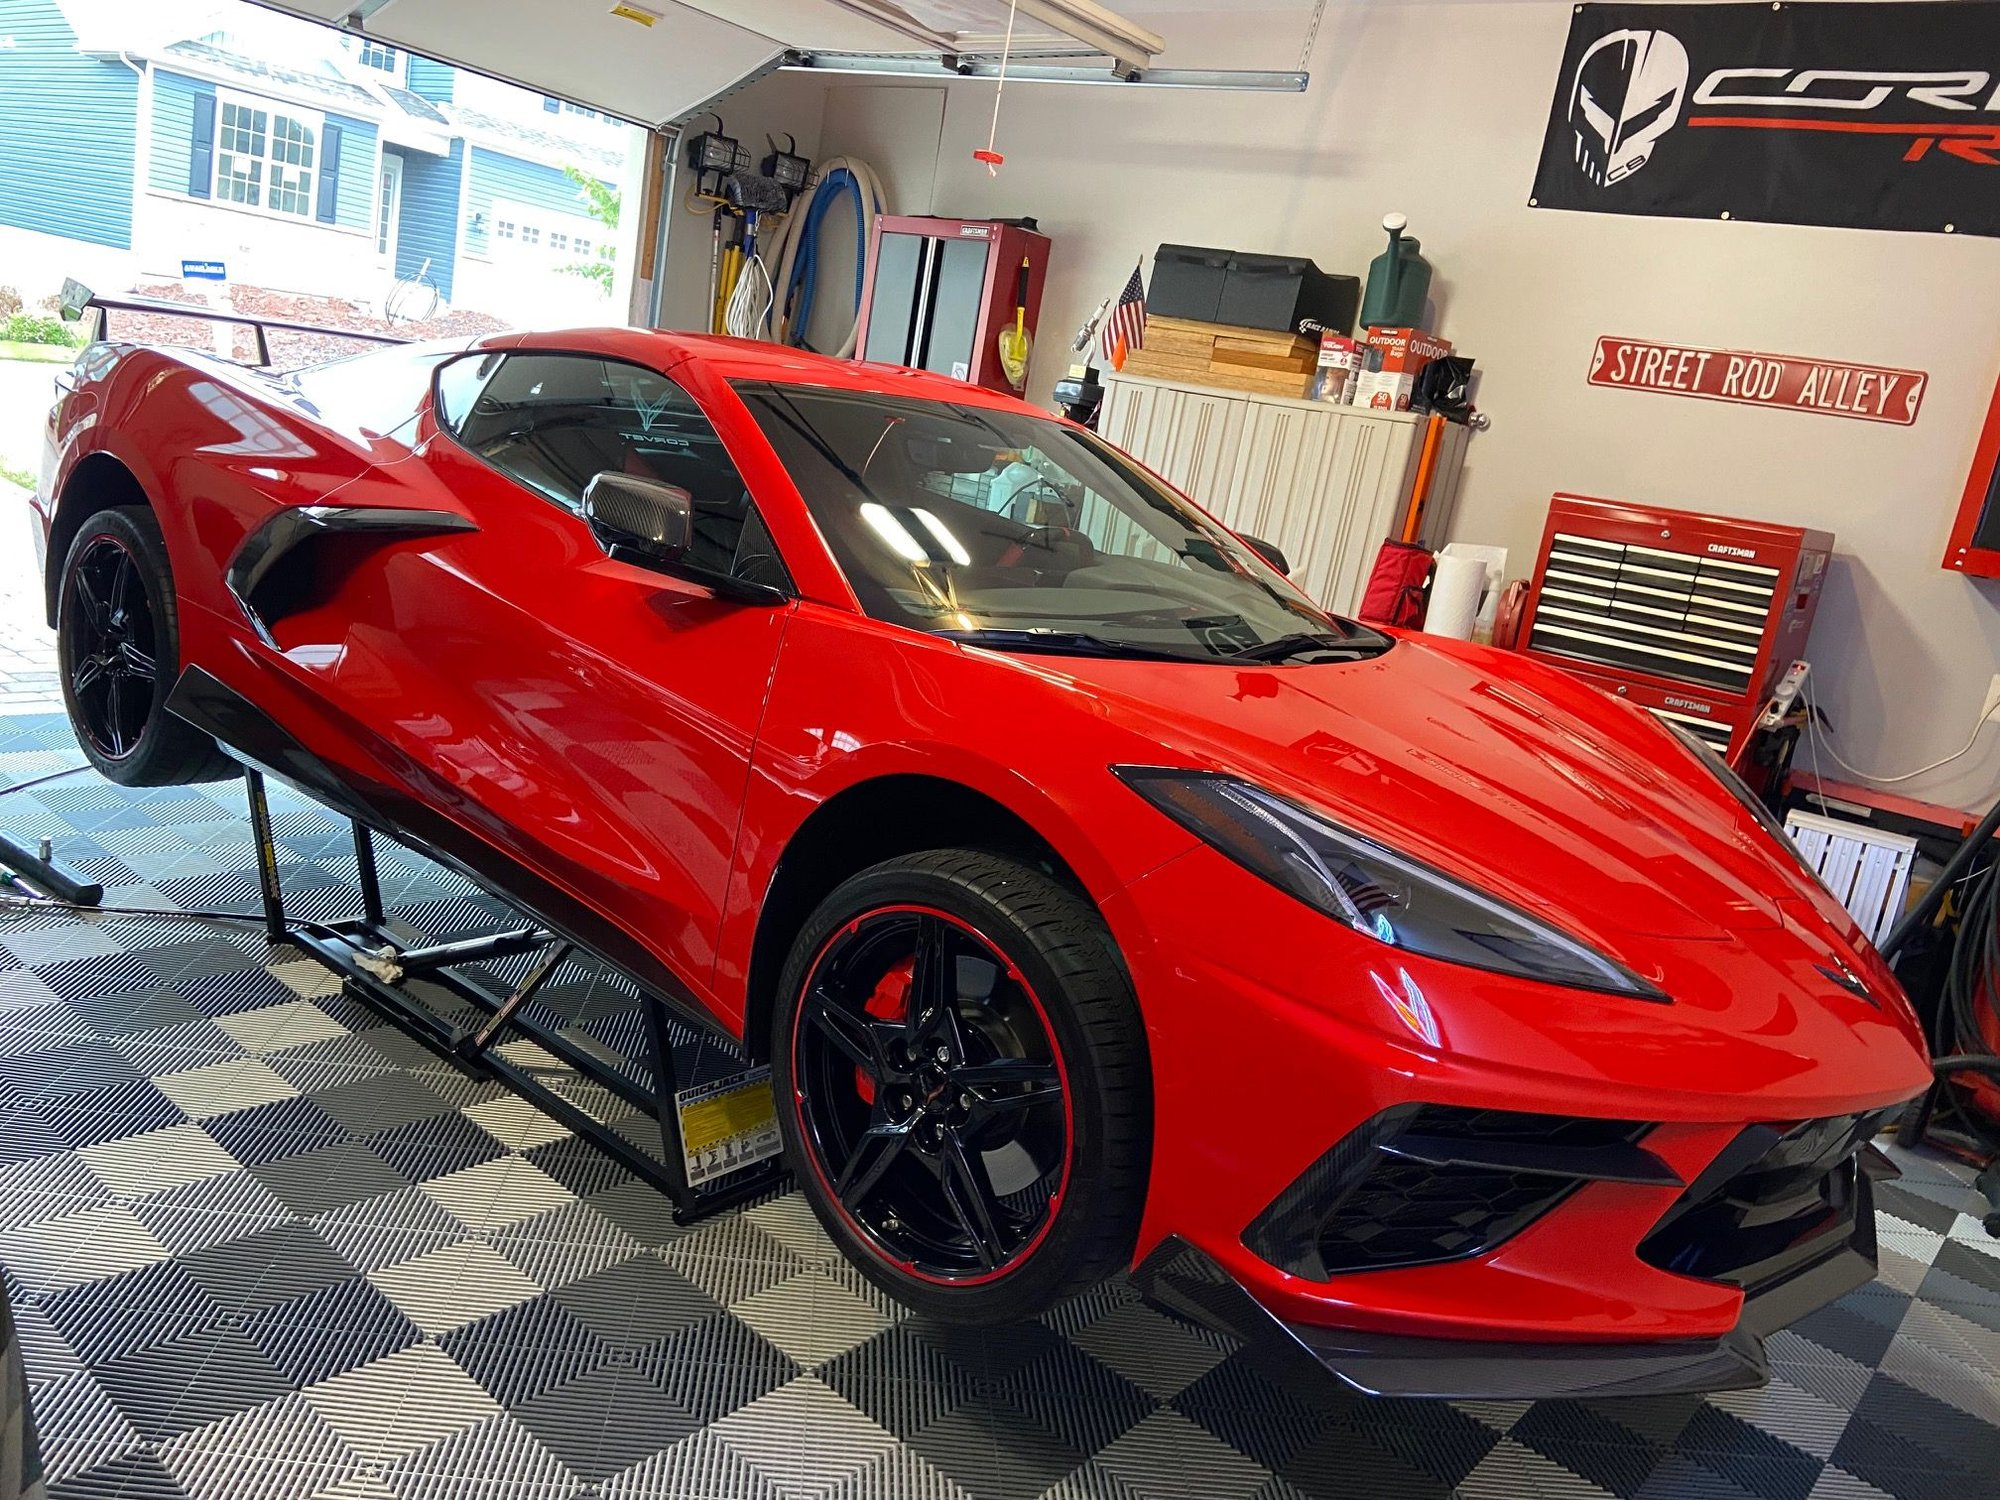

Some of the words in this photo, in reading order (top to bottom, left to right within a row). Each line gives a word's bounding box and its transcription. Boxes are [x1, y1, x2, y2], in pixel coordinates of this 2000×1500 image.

[1693, 68, 2000, 111] COR
[1607, 155, 1646, 181] C8
[1369, 336, 1406, 347] OUTDOOR
[1610, 344, 1712, 391] STREET
[1721, 357, 1783, 400] ROD
[1797, 366, 1899, 415] ALLEY
[1377, 392, 1388, 401] 50
[1707, 543, 1756, 559] CRAFTSMAN
[1664, 696, 1711, 713] CRAFTSMAN
